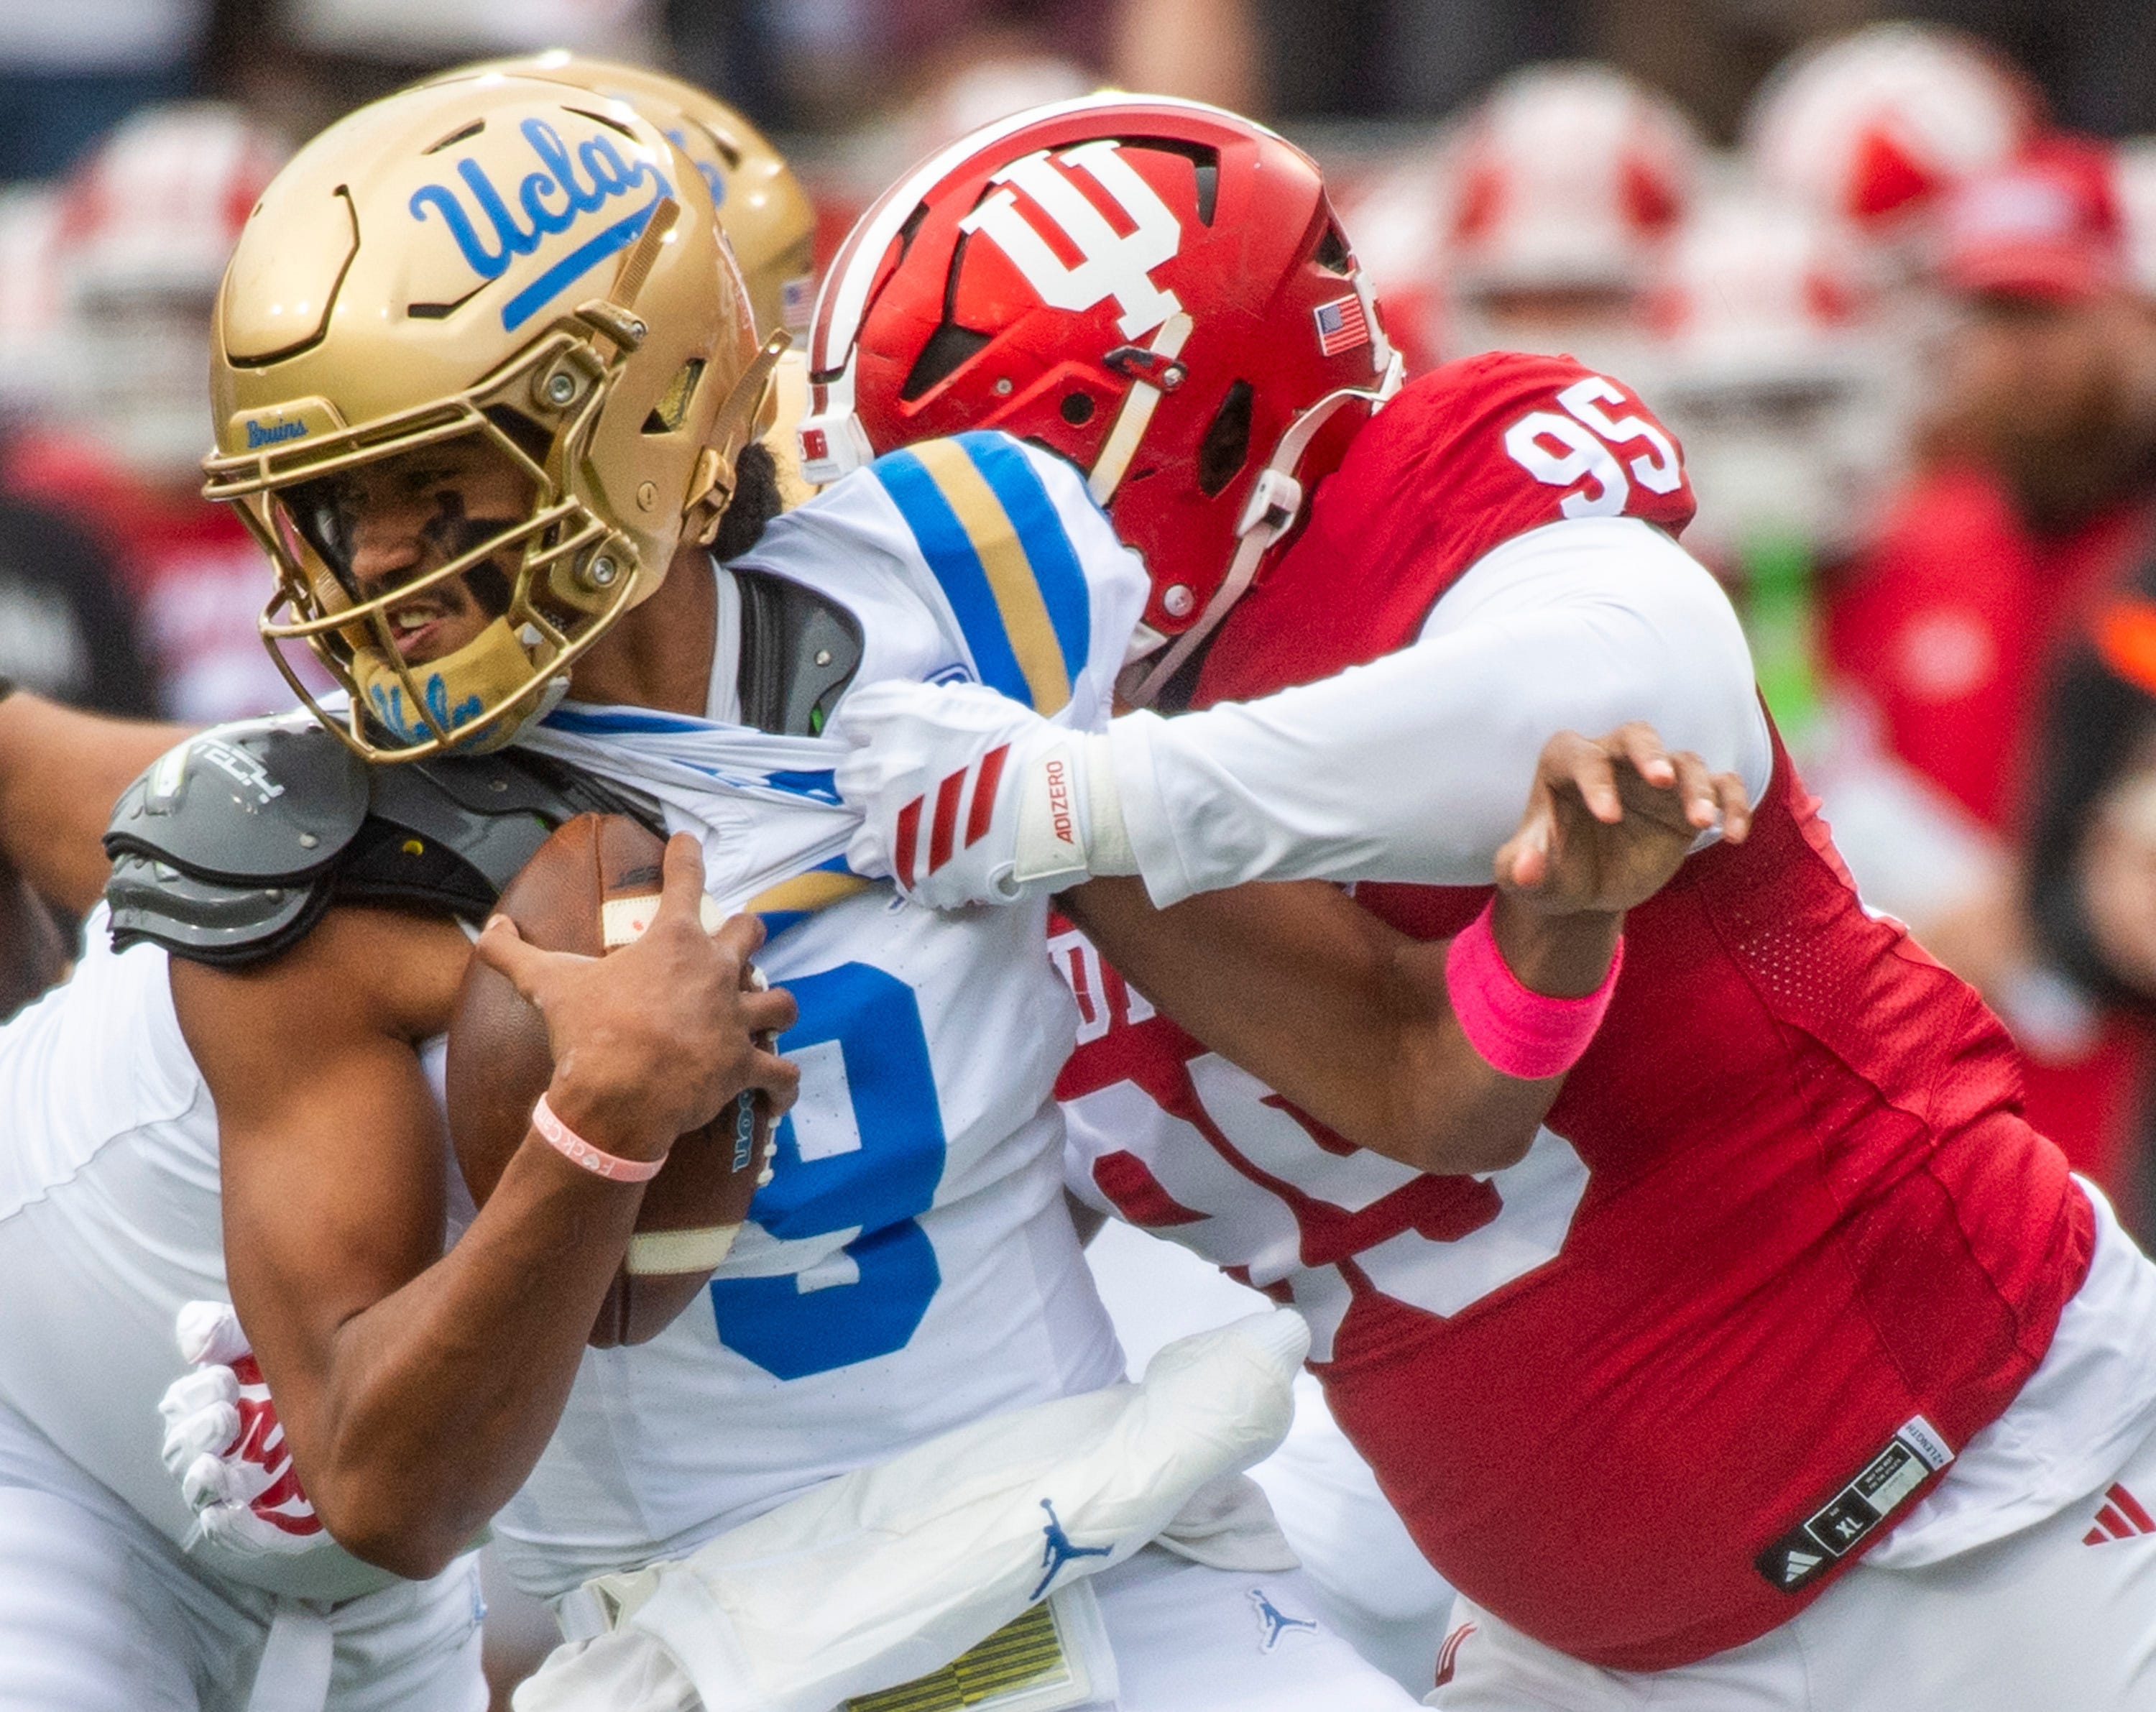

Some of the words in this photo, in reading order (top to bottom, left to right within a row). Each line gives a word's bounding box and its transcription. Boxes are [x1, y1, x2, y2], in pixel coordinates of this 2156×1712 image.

[247, 418, 309, 448] Bruins
[1504, 376, 1682, 520] 95
[1046, 760, 1074, 845] ADIZERO
[709, 961, 947, 1381] 9
[1835, 1517, 1864, 1539] XL
